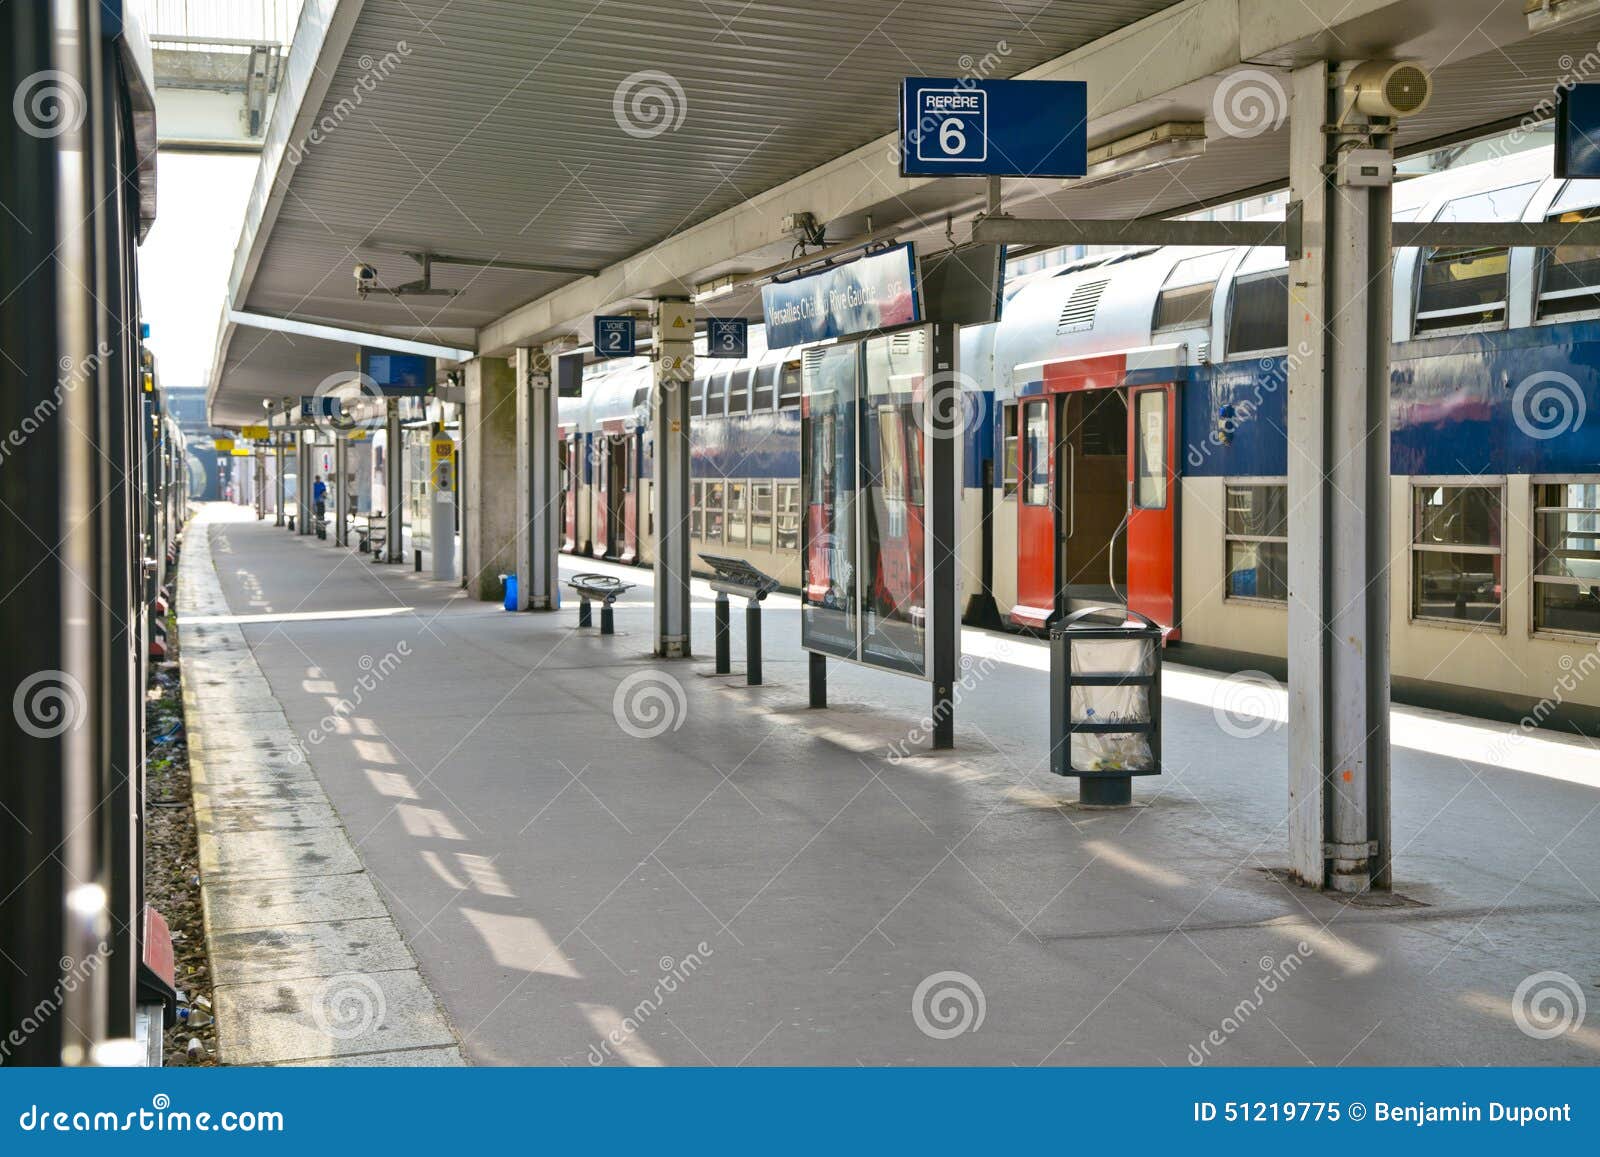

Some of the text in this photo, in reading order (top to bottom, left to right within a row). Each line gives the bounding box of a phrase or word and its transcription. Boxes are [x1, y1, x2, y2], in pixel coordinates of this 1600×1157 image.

[939, 117, 966, 155] 6
[768, 283, 876, 327] Versailles Châu Rive Gauche
[606, 322, 624, 330] VOIE
[608, 332, 622, 350] 2
[722, 334, 735, 351] 3
